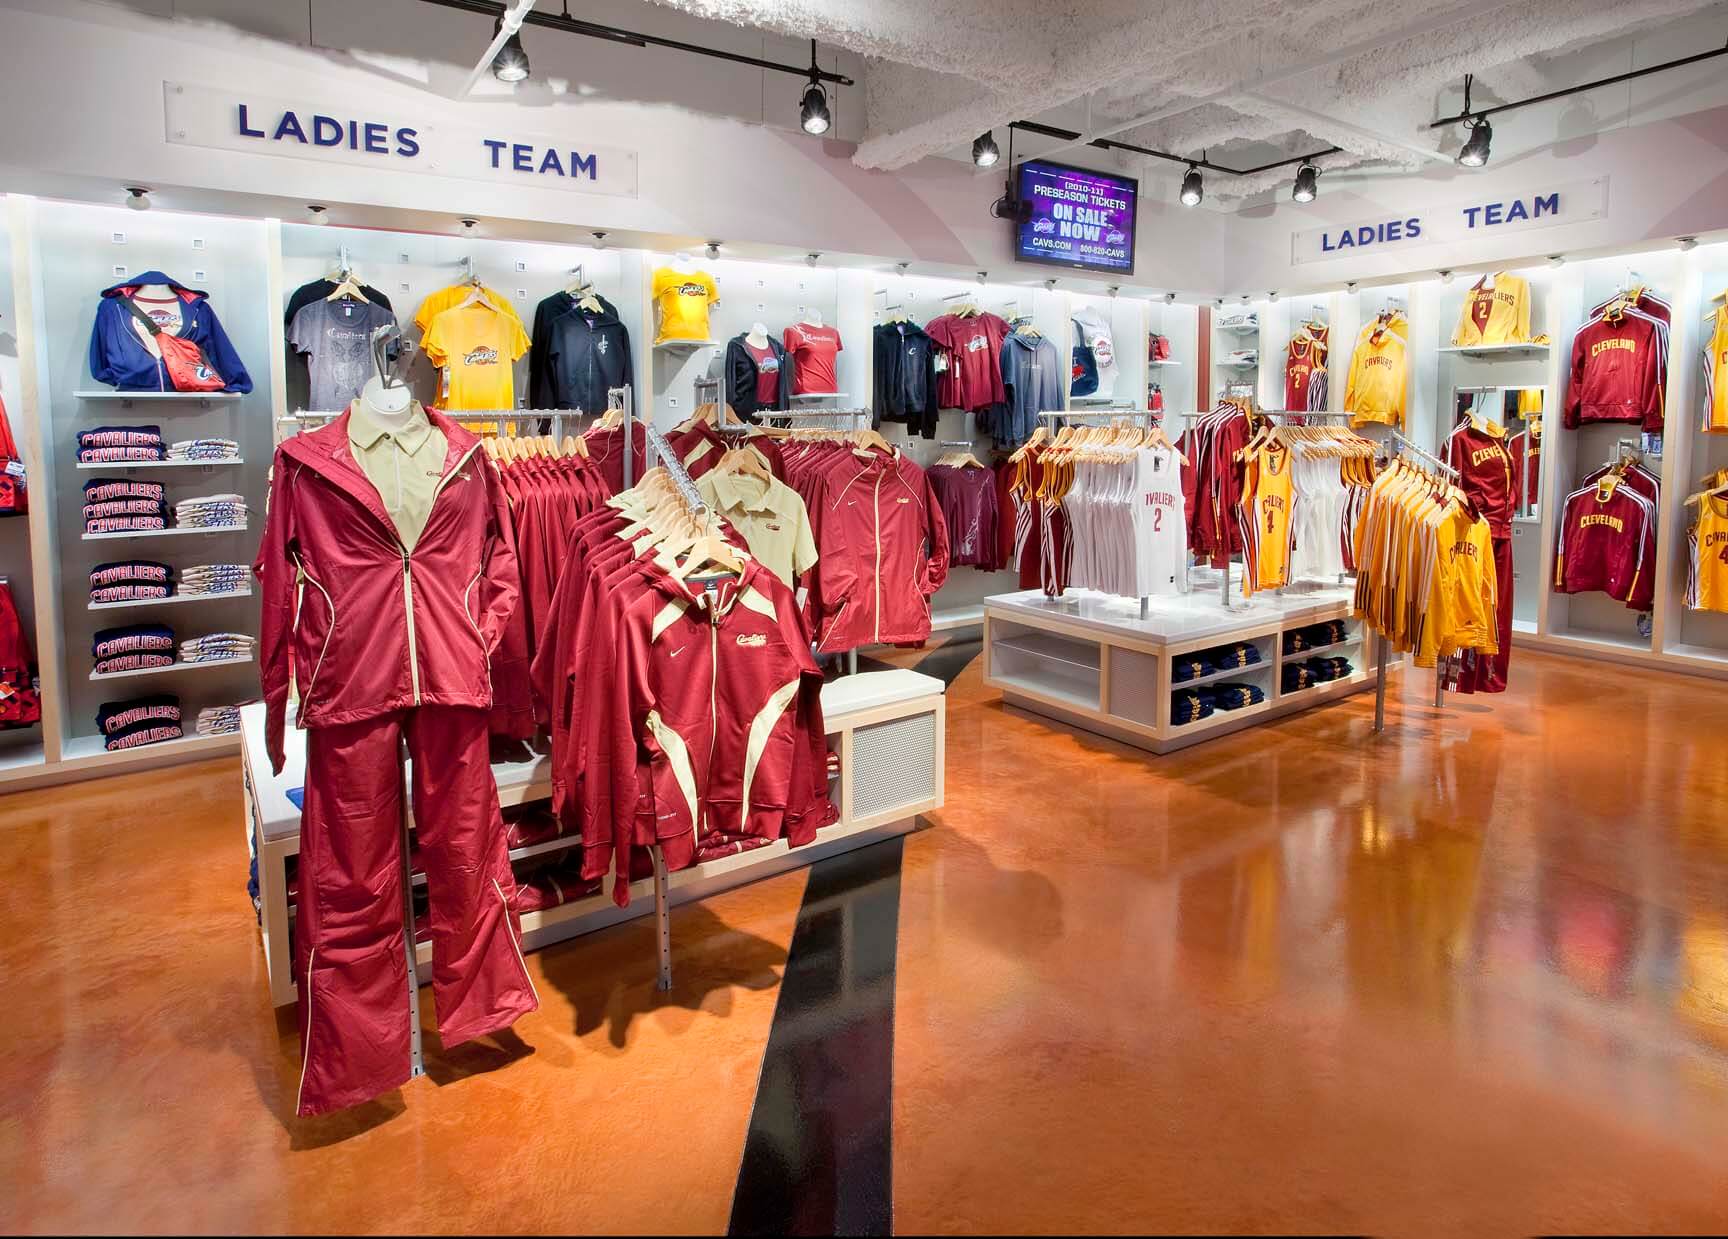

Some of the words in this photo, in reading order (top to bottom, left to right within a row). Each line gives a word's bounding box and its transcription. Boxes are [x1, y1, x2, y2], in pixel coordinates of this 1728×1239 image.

[238, 104, 420, 157] LADIES
[483, 140, 598, 181] TEAM
[1034, 184, 1088, 203] PRESEASON
[1091, 195, 1126, 210] TICKETS
[1053, 203, 1073, 221] ON
[1076, 206, 1108, 226] SALE
[1322, 218, 1421, 252] LADIES
[1463, 193, 1559, 228] TEAM
[1060, 221, 1100, 242] NOW
[1032, 237, 1072, 251] CAVS.COM
[1479, 301, 1488, 319] 2
[1592, 338, 1636, 357] CLEVELAND
[81, 431, 161, 447] CAVALIERS
[81, 447, 160, 463] CAVALIERS
[86, 483, 163, 501] CAVALIERS
[83, 500, 160, 518] CAVALIERS
[87, 517, 164, 534] CAVALIERS
[1153, 508, 1162, 532] 2
[1266, 511, 1275, 533] 4
[1580, 514, 1624, 533] CLEVELAND
[90, 565, 166, 586] CAVALIERS
[90, 585, 166, 603] CAVALIERS
[96, 636, 173, 658] CAVALIERS
[96, 655, 173, 674] CAVALIERS
[106, 706, 181, 733] CAVALIERS
[107, 727, 183, 751] CAVALIERS
